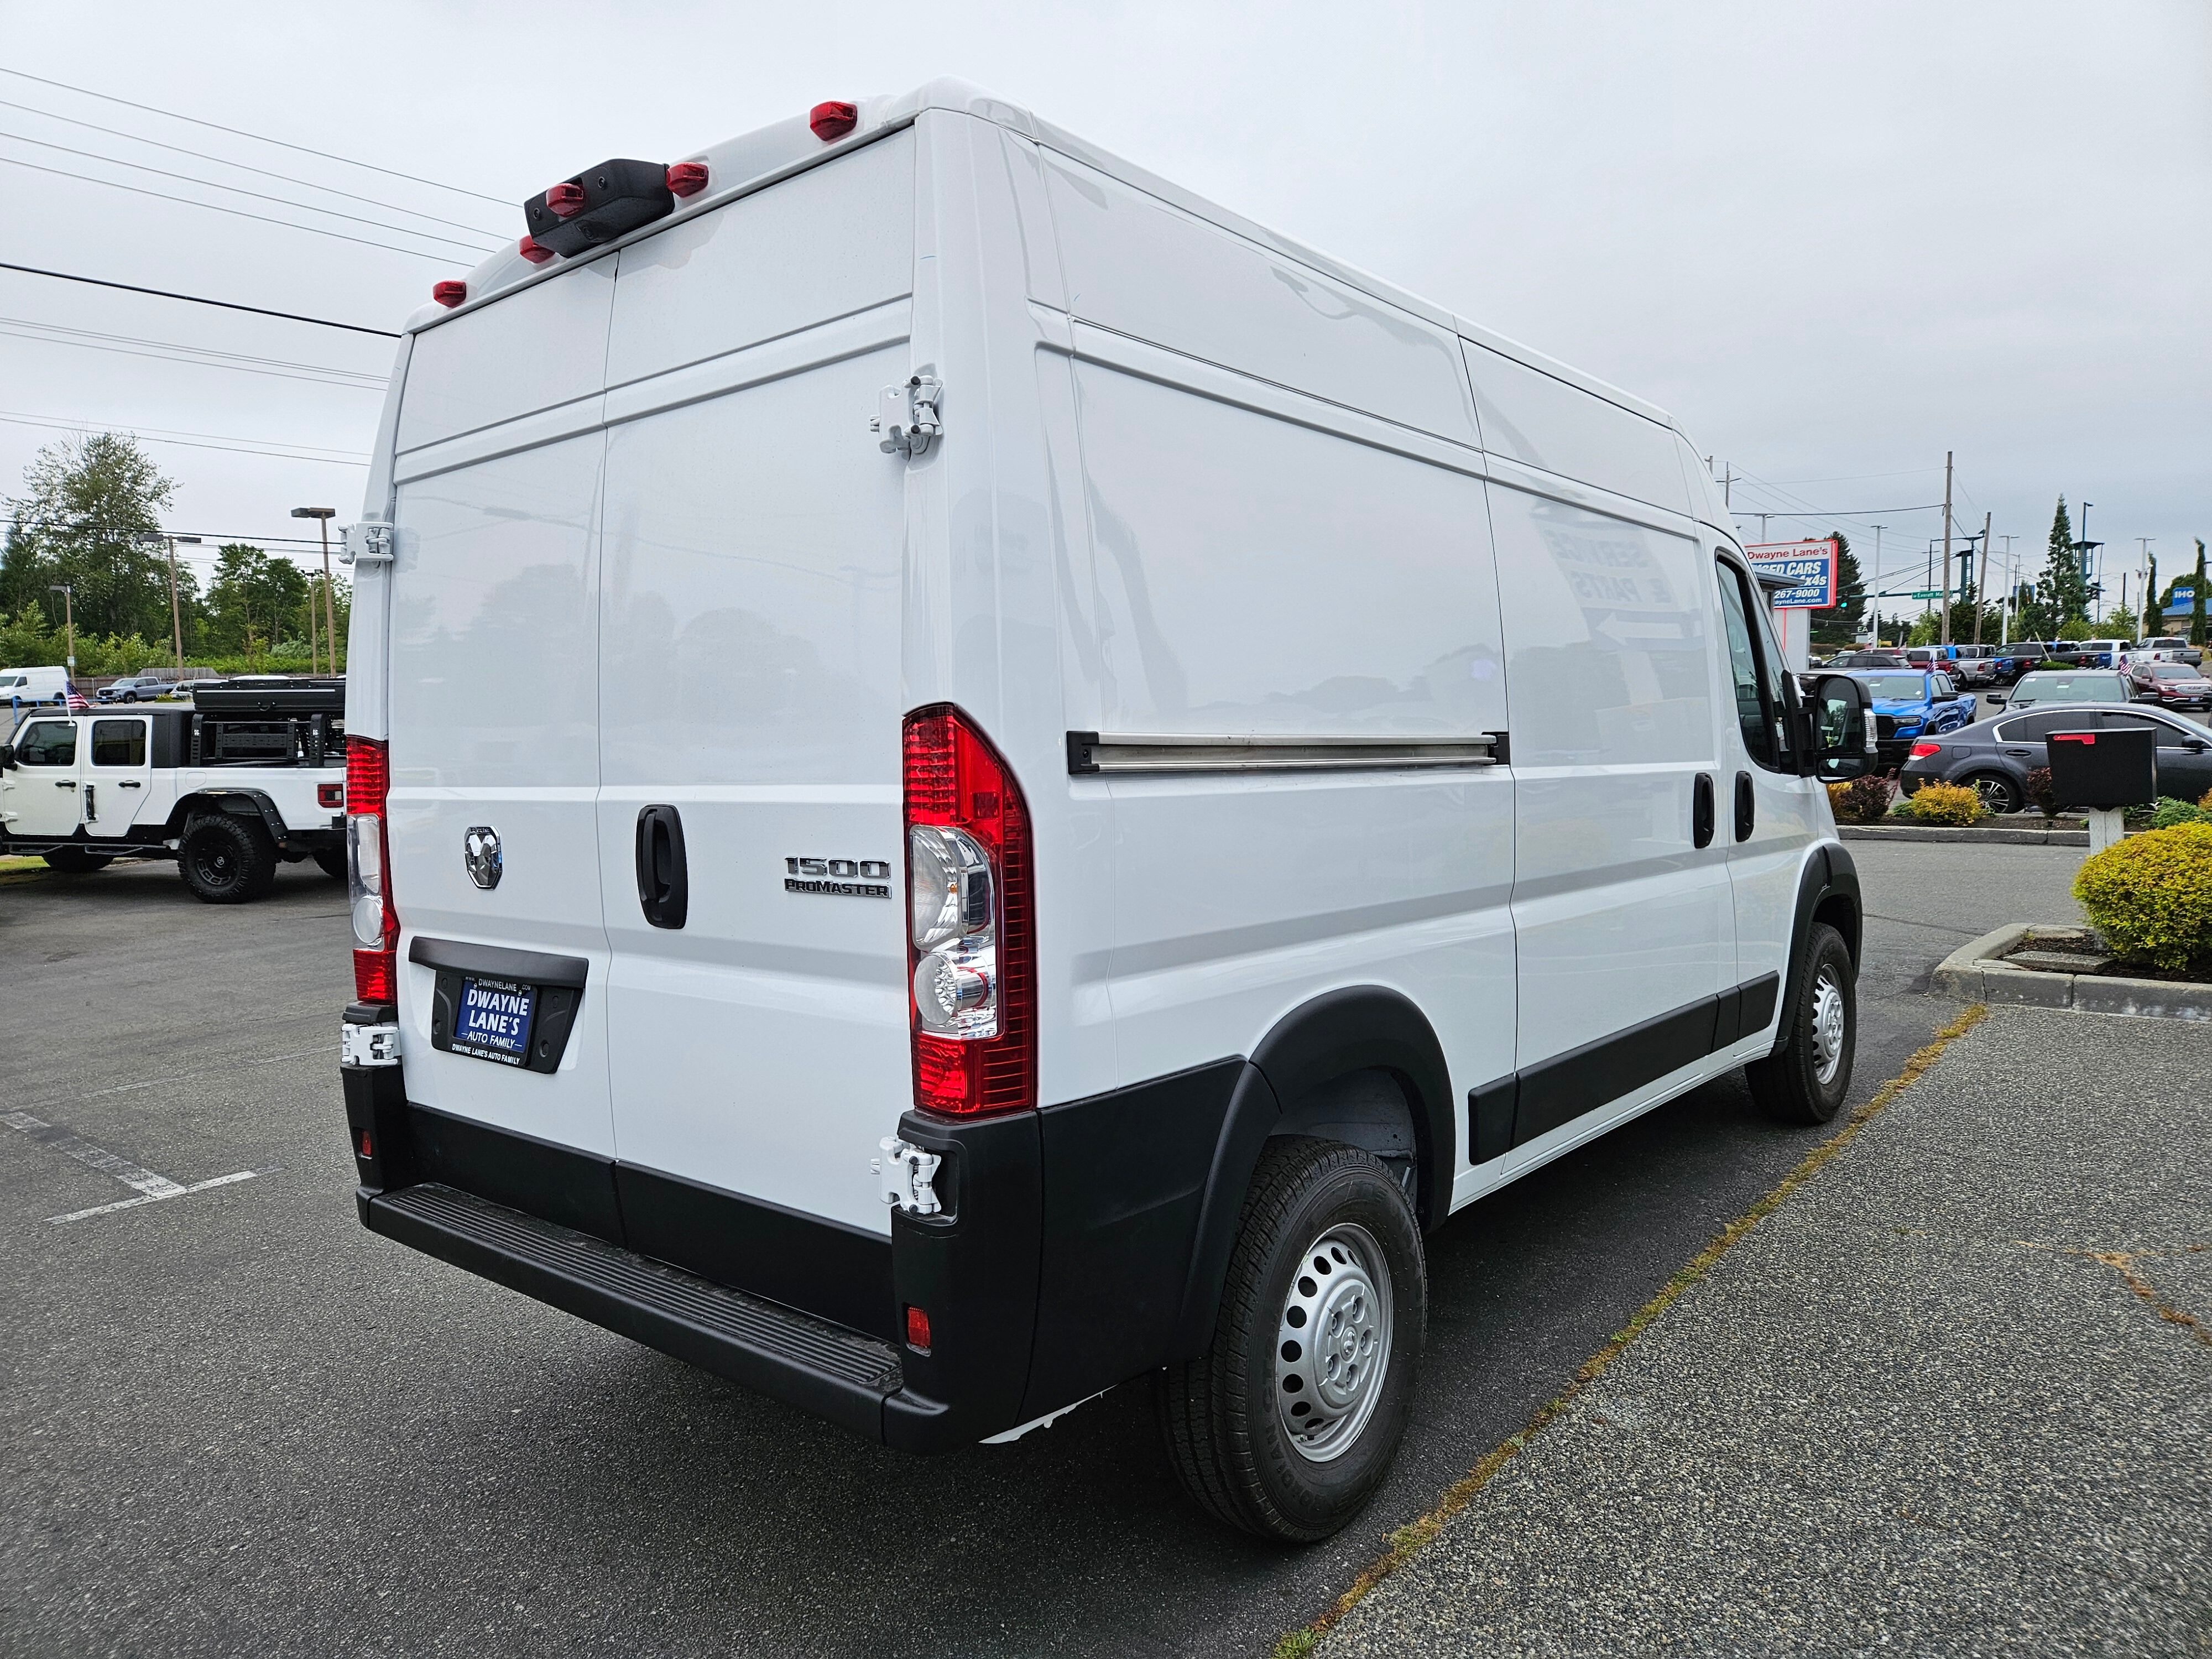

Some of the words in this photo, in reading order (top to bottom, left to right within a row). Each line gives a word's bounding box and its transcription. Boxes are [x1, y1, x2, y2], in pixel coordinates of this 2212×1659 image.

[1747, 551, 1790, 560] Dwayne
[1793, 547, 1828, 556] Lane's
[1787, 561, 1822, 576] CARS
[1774, 589, 1820, 599] 267-9000
[784, 857, 891, 879] 1500
[478, 978, 517, 992] DWAYNELANE
[467, 989, 530, 1016] DWAYNE
[468, 1010, 520, 1036] LANE'S
[467, 1031, 488, 1043] AUTO
[489, 1035, 515, 1049] FAMILY
[452, 1043, 472, 1054] DWAYNE
[471, 1047, 488, 1058] LANE'S
[487, 1051, 501, 1061] AUTO
[501, 1054, 520, 1065] FAMILY
